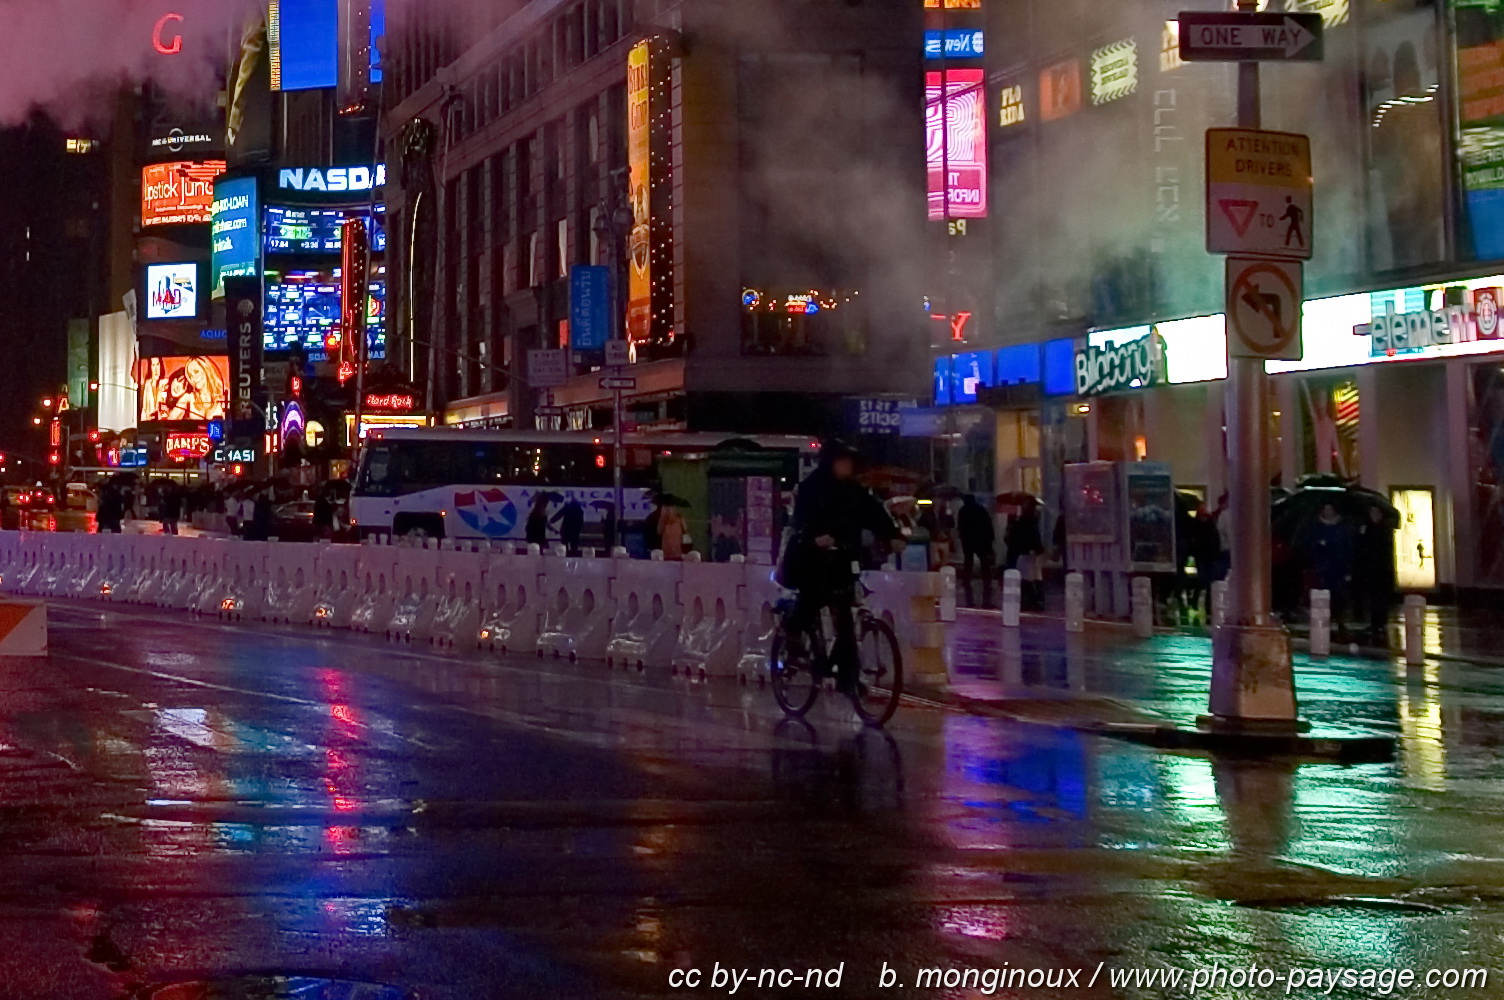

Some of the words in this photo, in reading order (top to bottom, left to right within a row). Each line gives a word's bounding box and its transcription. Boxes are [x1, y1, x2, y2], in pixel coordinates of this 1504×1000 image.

[1200, 27, 1243, 46] ONE
[1261, 28, 1302, 46] WAY
[1227, 137, 1299, 157] ATTENTION
[1235, 159, 1292, 177] DRIVERS
[1259, 213, 1275, 229] TO
[1371, 300, 1477, 349] element
[239, 322, 252, 414] REUTERS
